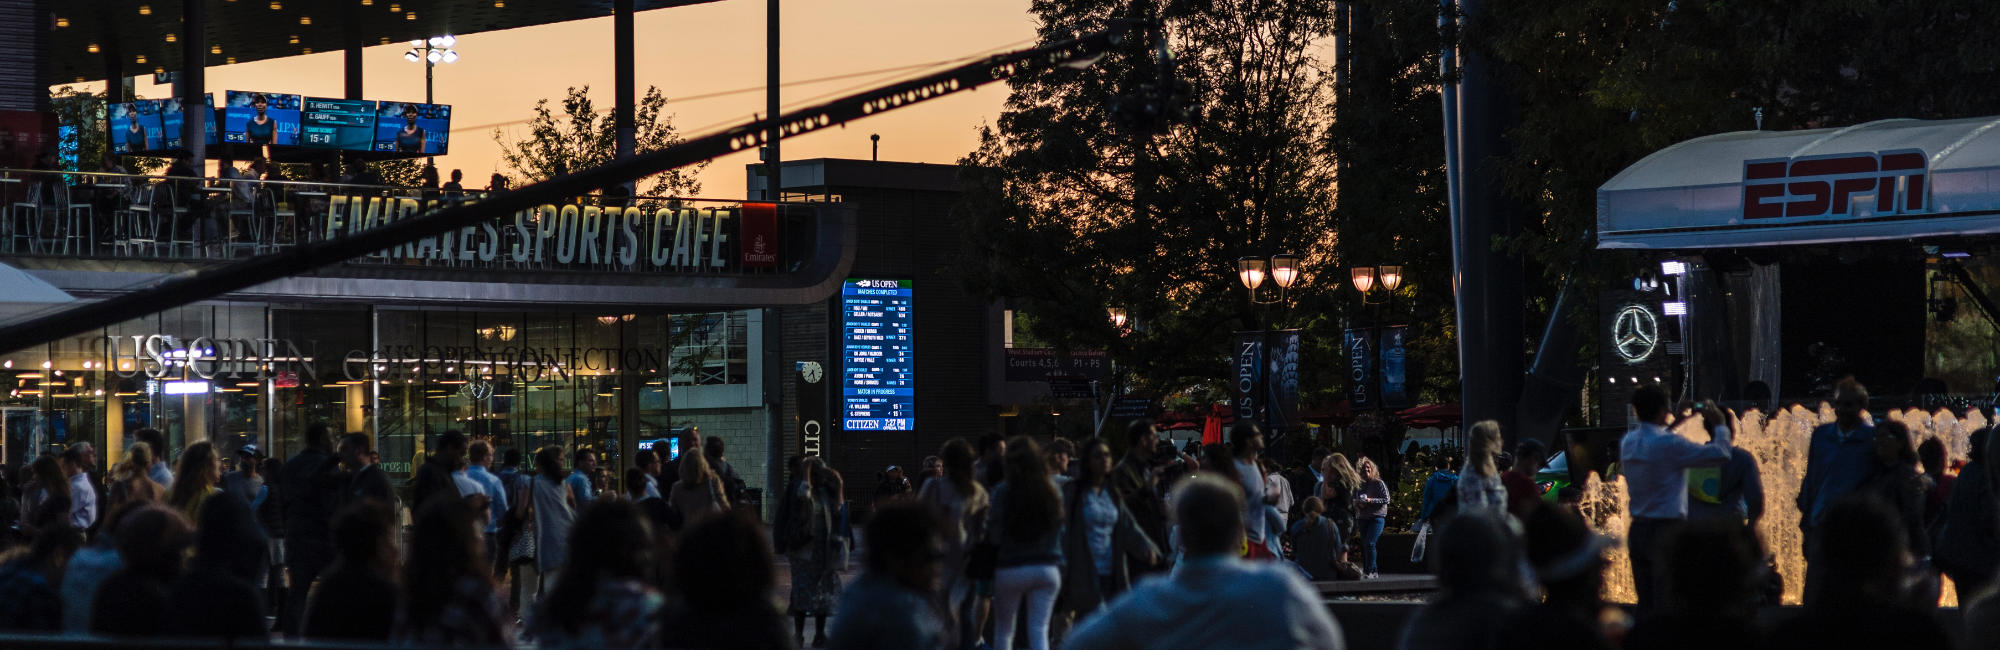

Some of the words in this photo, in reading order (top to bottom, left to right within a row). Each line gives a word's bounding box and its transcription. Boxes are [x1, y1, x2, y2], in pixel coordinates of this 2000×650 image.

[1743, 148, 1928, 221] ESPN
[511, 203, 641, 267] SPORTS
[651, 207, 730, 267] CAFE
[744, 251, 776, 263] Emirates
[872, 279, 880, 288] US
[880, 280, 898, 288] OPEN
[108, 334, 168, 378] US
[188, 336, 318, 381] OPEN
[1009, 358, 1037, 368] Courts
[1239, 341, 1255, 394] OPEN
[1352, 336, 1364, 382] OPEN
[846, 419, 879, 429] CITIZEN
[1240, 396, 1254, 419] US
